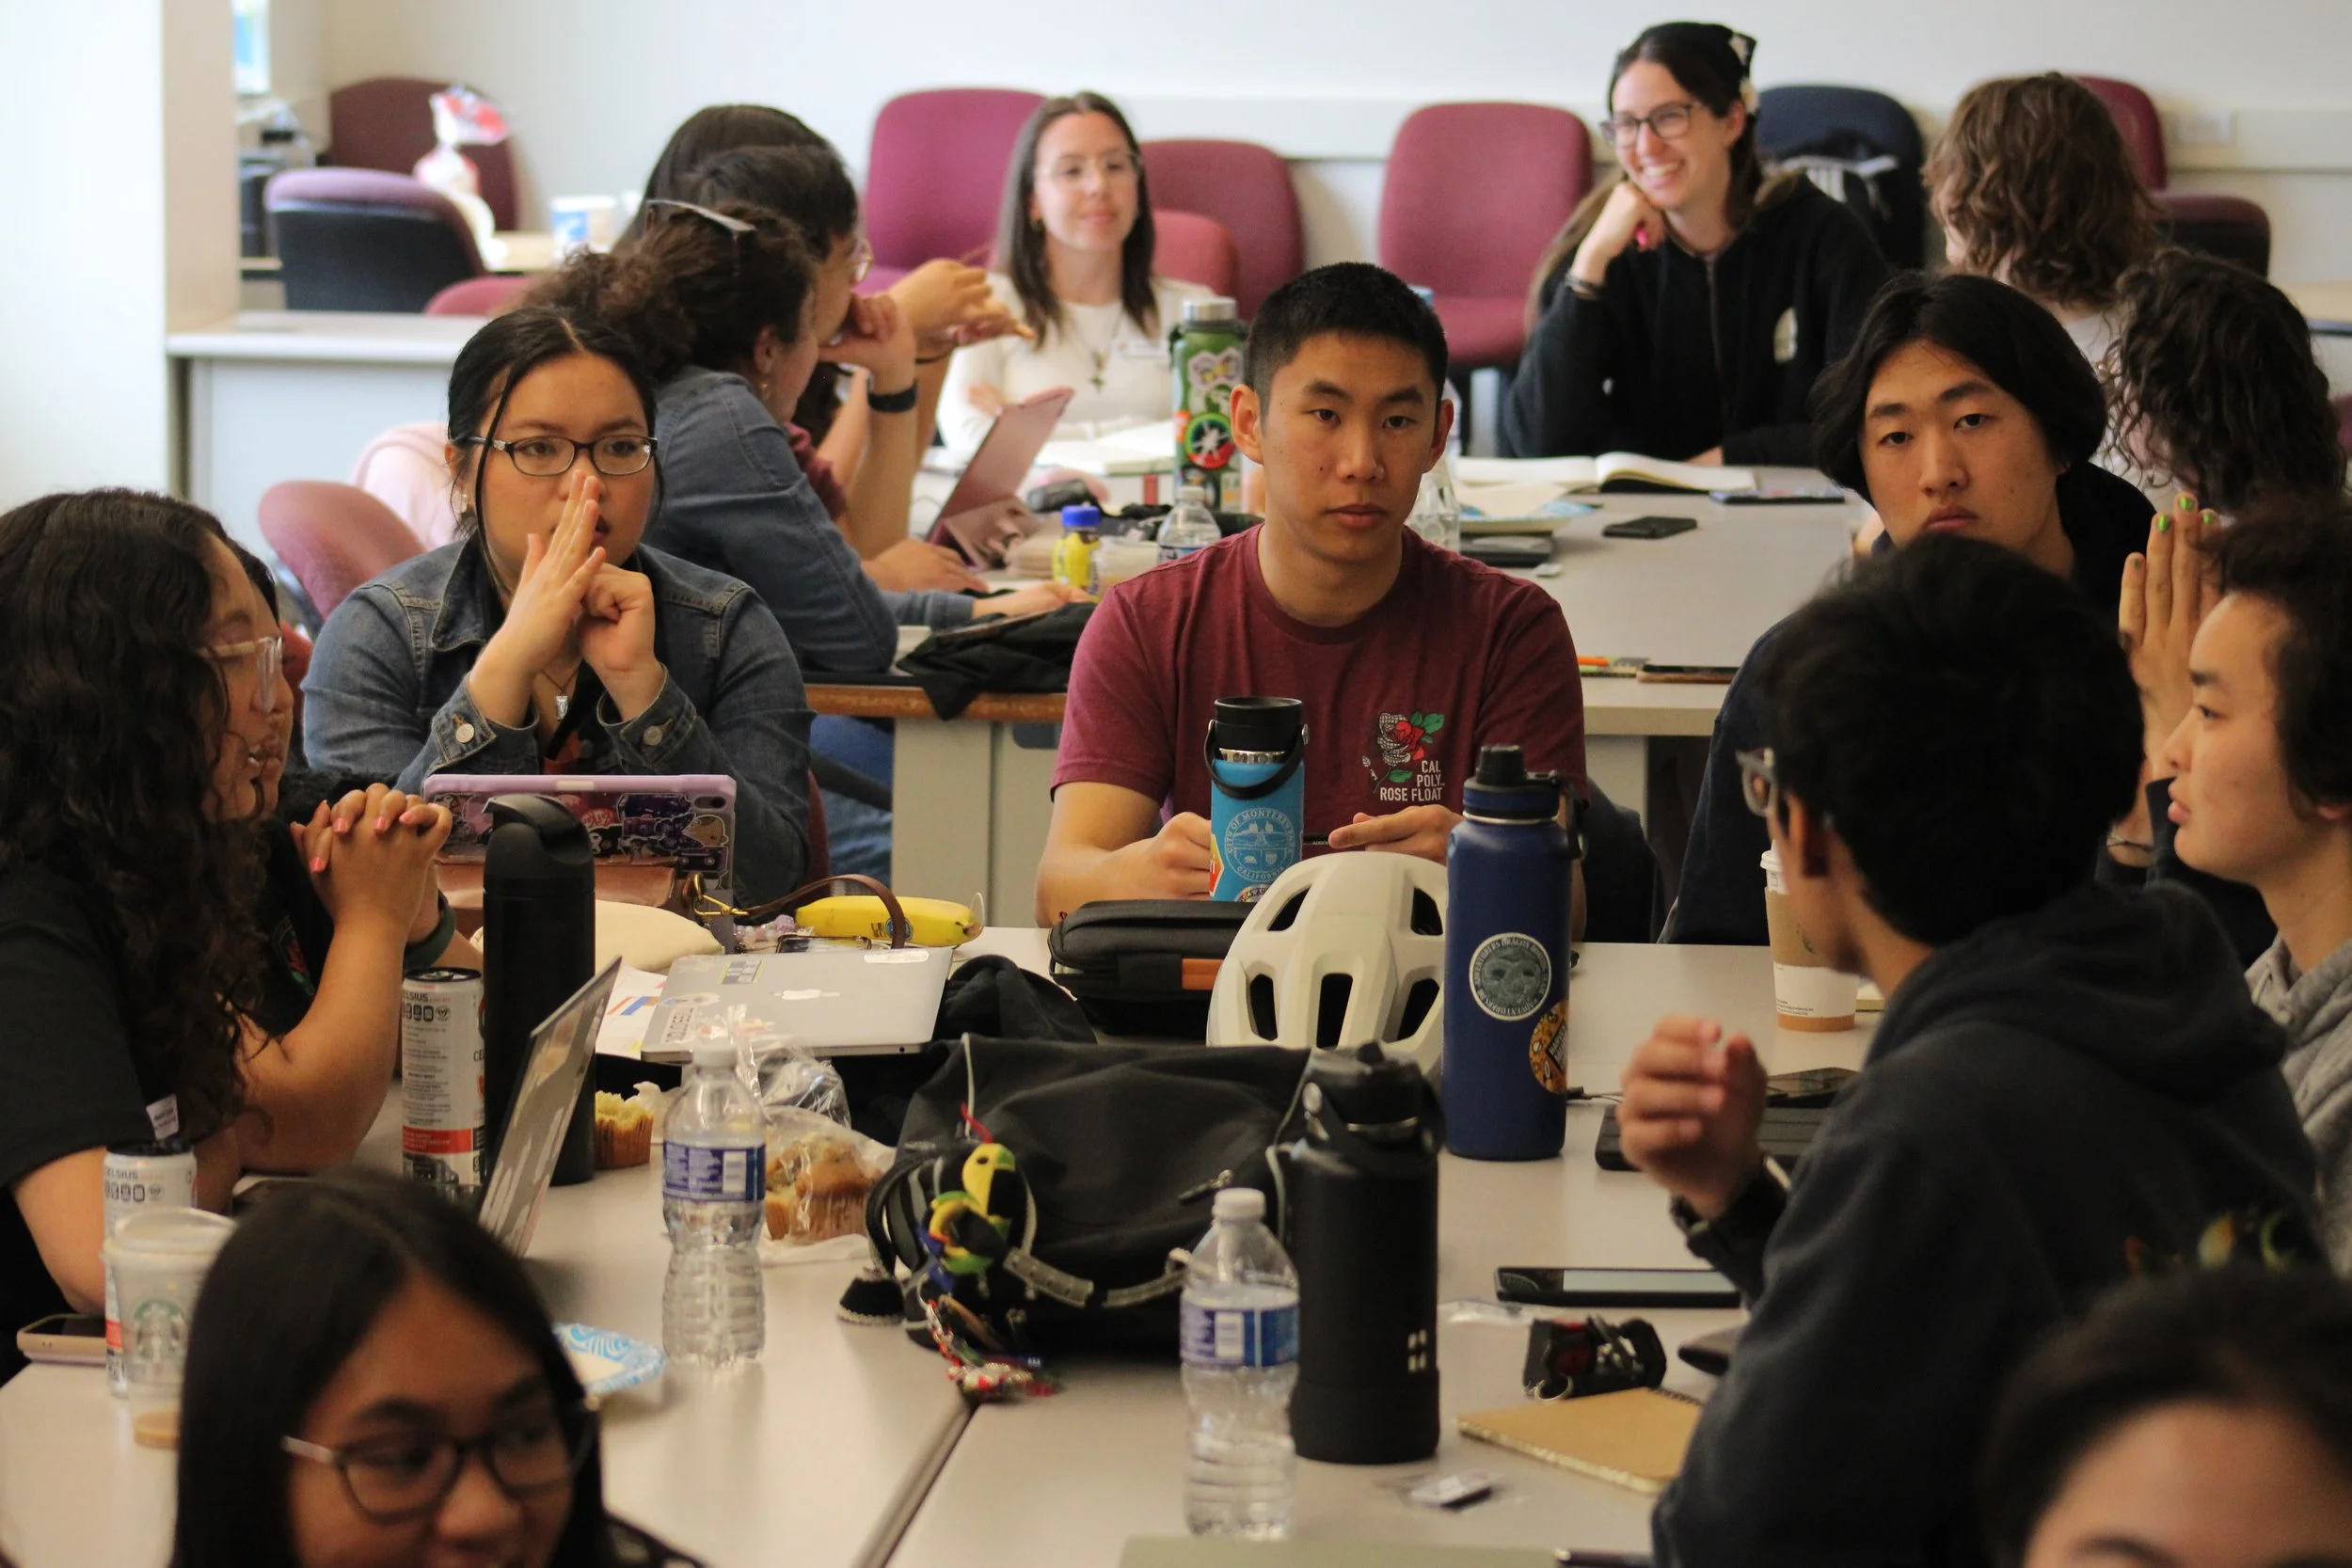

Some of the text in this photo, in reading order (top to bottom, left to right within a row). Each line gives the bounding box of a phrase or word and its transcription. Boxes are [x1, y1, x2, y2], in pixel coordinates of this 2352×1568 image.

[1422, 760, 1441, 773] CAL
[1417, 774, 1441, 787] POLY
[1380, 787, 1442, 801] ROSE FLOAT
[1231, 819, 1241, 830] OF
[1237, 865, 1285, 879] CALIFORNIA
